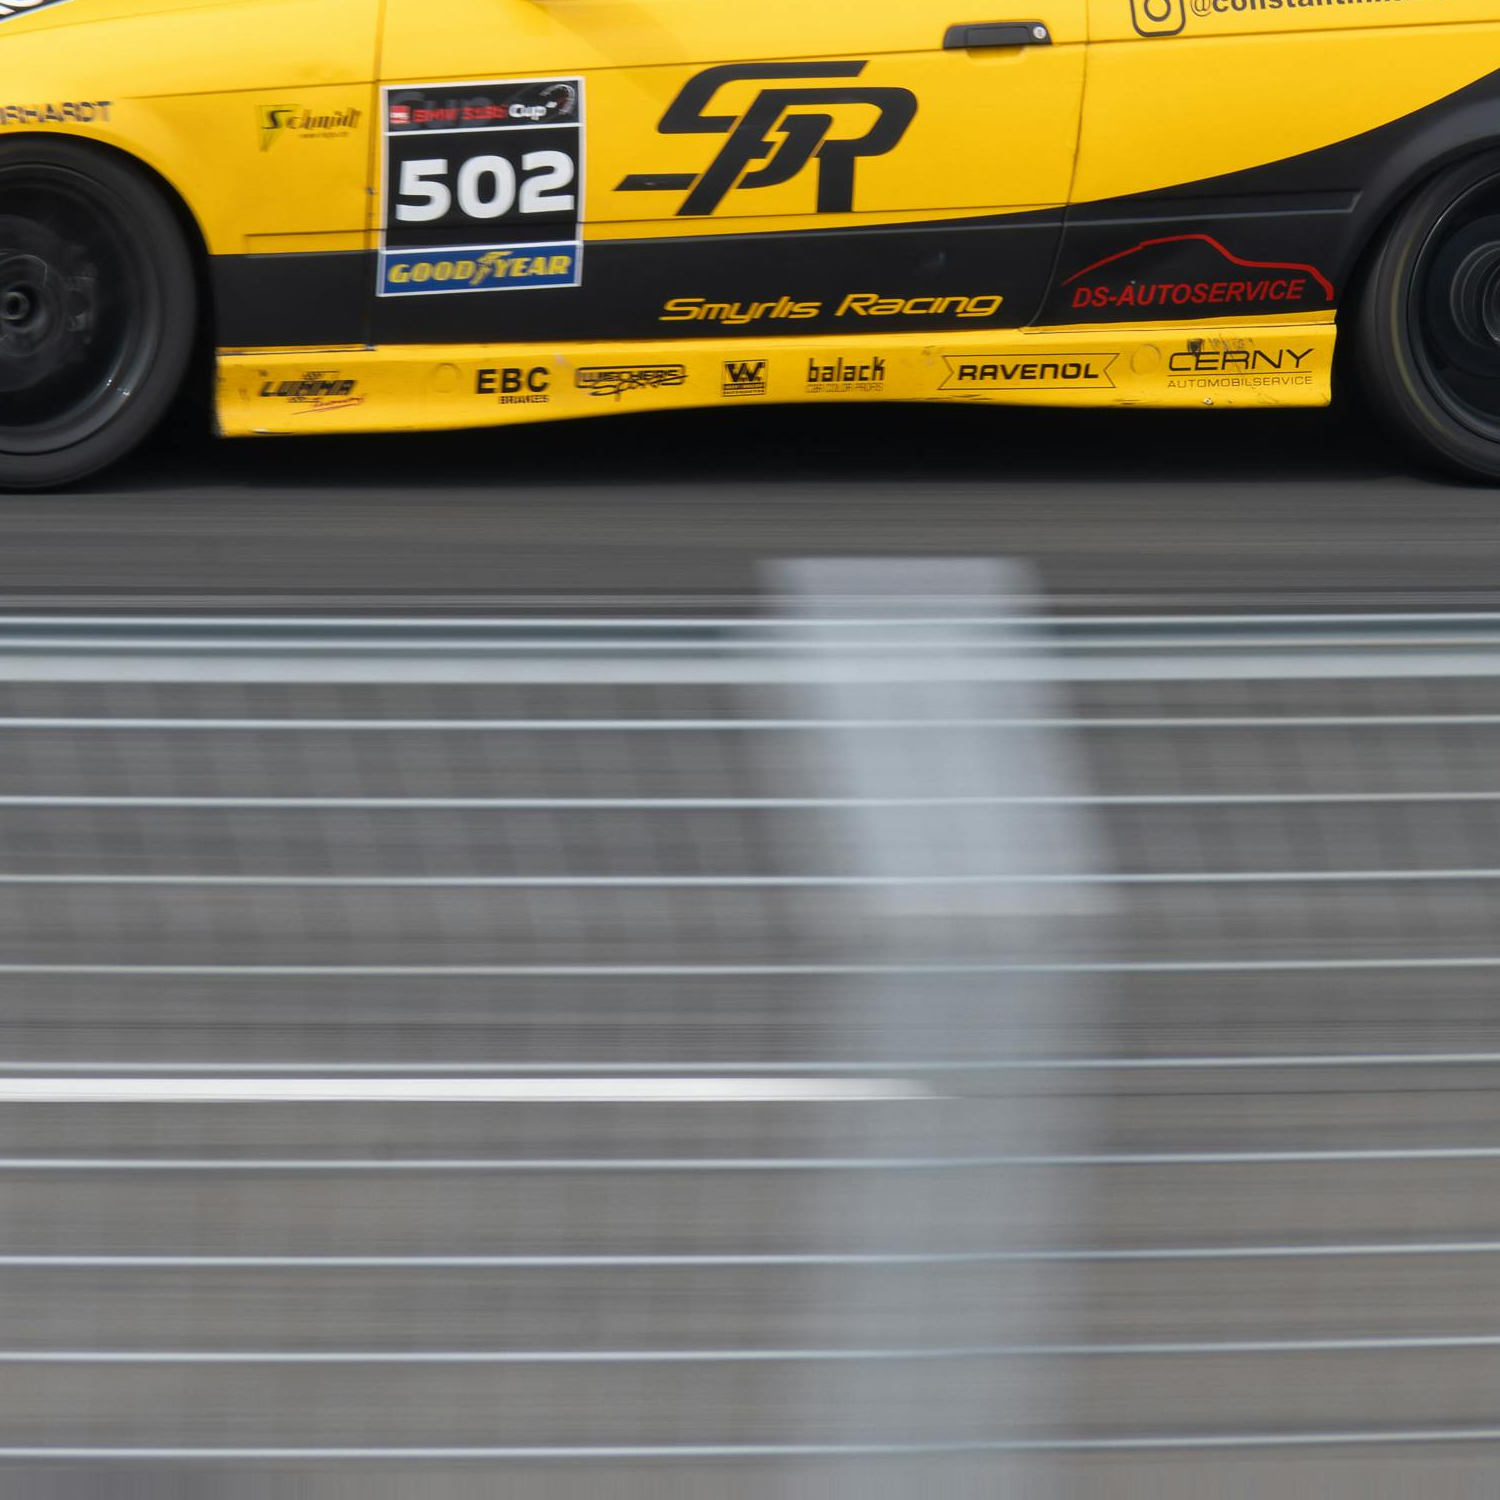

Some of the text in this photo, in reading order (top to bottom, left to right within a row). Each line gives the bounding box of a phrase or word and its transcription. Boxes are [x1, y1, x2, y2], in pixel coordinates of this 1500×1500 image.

[508, 104, 548, 121] Cup
[395, 150, 575, 222] 502
[1072, 278, 1307, 309] DS-AUTOSERVICE
[657, 293, 1003, 325] Smyrlis Racing
[476, 365, 550, 394] EBC
[807, 356, 886, 382] balack
[957, 362, 1100, 381] RAVENOL
[1167, 375, 1314, 389] AUTOMOBILSERVICE
